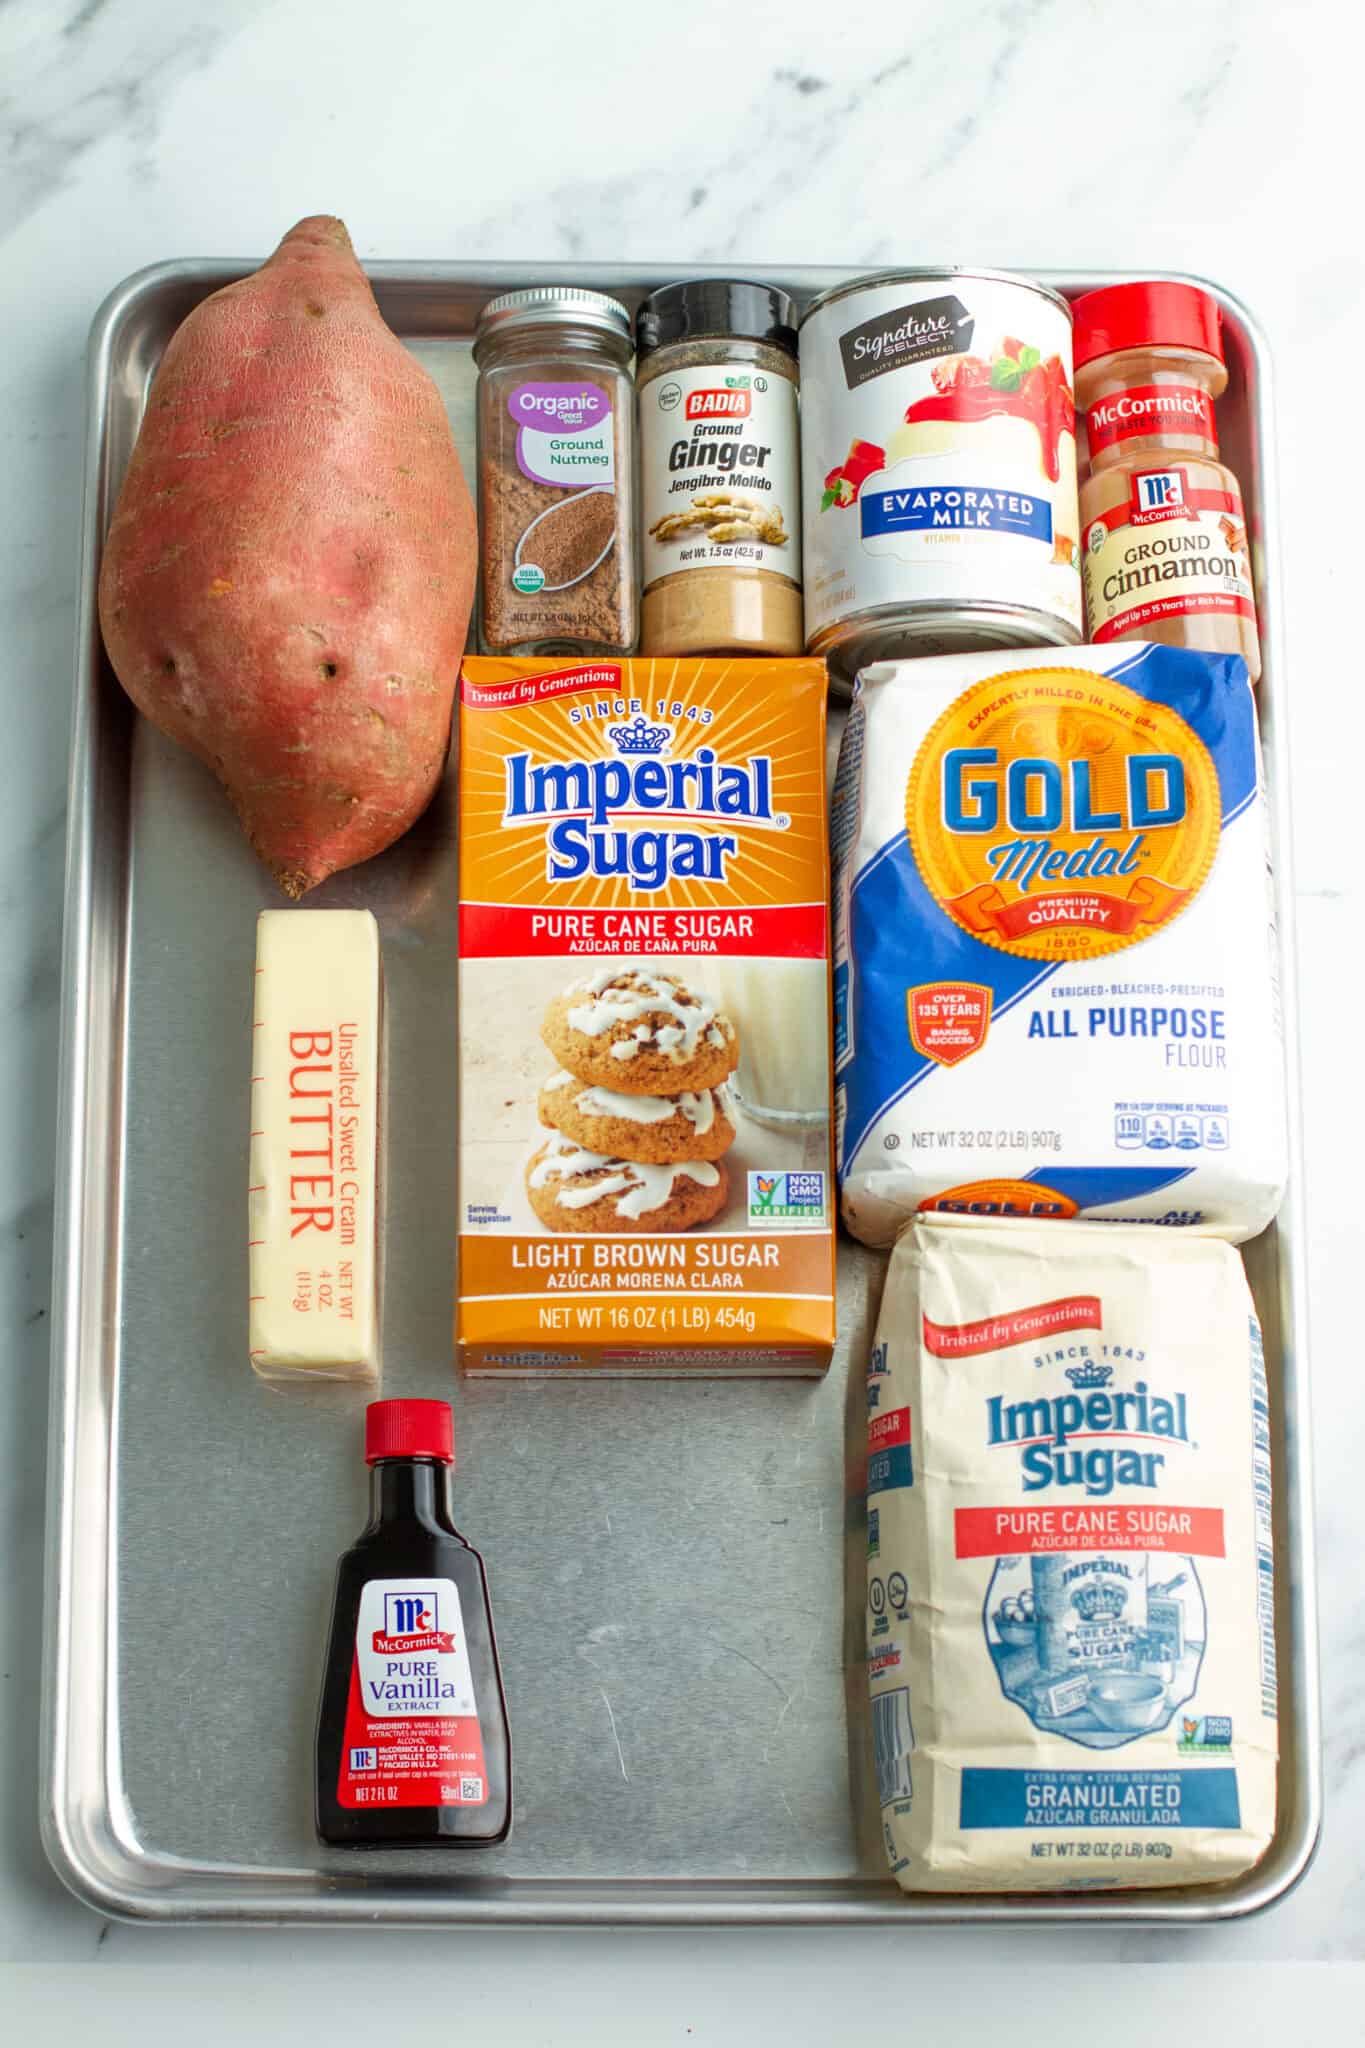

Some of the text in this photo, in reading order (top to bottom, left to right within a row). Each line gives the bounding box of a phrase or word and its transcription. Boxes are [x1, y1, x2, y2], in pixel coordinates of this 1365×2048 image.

[852, 313, 952, 362] Signature
[883, 329, 949, 356] SELECT
[857, 362, 893, 381] QUALITY
[519, 392, 599, 416] Organic
[689, 393, 746, 414] BADIA
[1091, 393, 1207, 431] McCormick
[693, 423, 744, 437] Ground
[549, 439, 604, 450] Ground
[668, 438, 772, 472] Ginger
[549, 454, 610, 467] Nutmeg
[668, 473, 773, 494] Jengibre Molido
[882, 492, 1034, 516] EVAPORATED
[932, 510, 991, 527] MILK
[1132, 507, 1191, 525] McCormick
[680, 549, 692, 561] Net
[709, 547, 722, 558] 1.5
[723, 548, 733, 557] oz
[1123, 535, 1211, 565] GROUND
[1102, 556, 1239, 602] Cinnamon
[1112, 617, 1130, 631] Aged
[1130, 611, 1141, 624] Up
[1142, 608, 1151, 617] to
[1152, 605, 1161, 614] 15
[1162, 600, 1184, 611] Years
[1184, 598, 1197, 607] for
[471, 669, 616, 704] Trusted by Generations
[570, 700, 713, 724] SINCE 1843
[967, 688, 1029, 731] EXPERTLY
[1034, 687, 1084, 701] MILLED
[1088, 694, 1104, 707] IN
[1108, 703, 1133, 719] THE
[506, 749, 772, 826] Imperial
[941, 747, 1187, 835] GOLD
[550, 819, 736, 890] Sugar
[985, 835, 1142, 894] Medal
[1037, 897, 1099, 909] PREMIUM
[531, 915, 754, 937] PURE CANE SUGAR
[1027, 907, 1112, 924] QUALITY
[569, 937, 718, 953] AZÚCAR DE CAÑA PURA
[1046, 936, 1091, 948] 1880
[932, 994, 966, 1003] OVER
[918, 1003, 981, 1016] 135 YEARS
[1027, 1006, 1226, 1040] ALL PURPOSE
[1164, 1043, 1227, 1069] FLOUR
[289, 1031, 335, 1239] BUTTER
[338, 1022, 361, 1246] Unsalted Sweet Cream
[1119, 1117, 1140, 1132] 110
[911, 1131, 1063, 1151] NET WT 32 OZ (2 LB) 907g
[789, 1175, 820, 1186] NON
[789, 1185, 821, 1196] GMO
[467, 1204, 498, 1215] Serving
[467, 1214, 512, 1224] Suggestion
[754, 1206, 821, 1216] VERIFIED
[511, 1244, 780, 1269] LIGHT BROWN SUGAR
[318, 1270, 333, 1279] 4
[546, 1270, 744, 1289] AZÚCAR MORENA CLARA
[338, 1261, 354, 1320] NET WT
[539, 1307, 756, 1332] NET WT 16 OZ (1 LB) 454g
[937, 1305, 1095, 1349] Trusted by Generations
[1034, 1345, 1147, 1369] SINCE 1843
[985, 1382, 1190, 1446] Imperial
[1021, 1443, 1165, 1496] Sugar
[996, 1511, 1193, 1535] PURE CANE SUGAR
[1031, 1534, 1165, 1548] AZÚCAR DE CAÑA PURA
[1062, 1560, 1133, 1586] IMPERIAL
[1066, 1625, 1135, 1640] PURE CANE
[376, 1636, 446, 1652] McCormick
[1068, 1642, 1137, 1658] SUGAR
[386, 1661, 438, 1677] PURE
[369, 1678, 456, 1700] Vanilla
[387, 1701, 441, 1711] EXTRACT
[1207, 1718, 1231, 1728] NON
[1207, 1727, 1232, 1736] GMO
[355, 1786, 399, 1801] NET 2 FL OZ
[1025, 1785, 1181, 1808] GRANULATED
[1024, 1807, 1181, 1825] AZÚCAR GRANULADA
[1031, 1842, 1173, 1859] NET WT 32 OZ (2 LB) 907g
